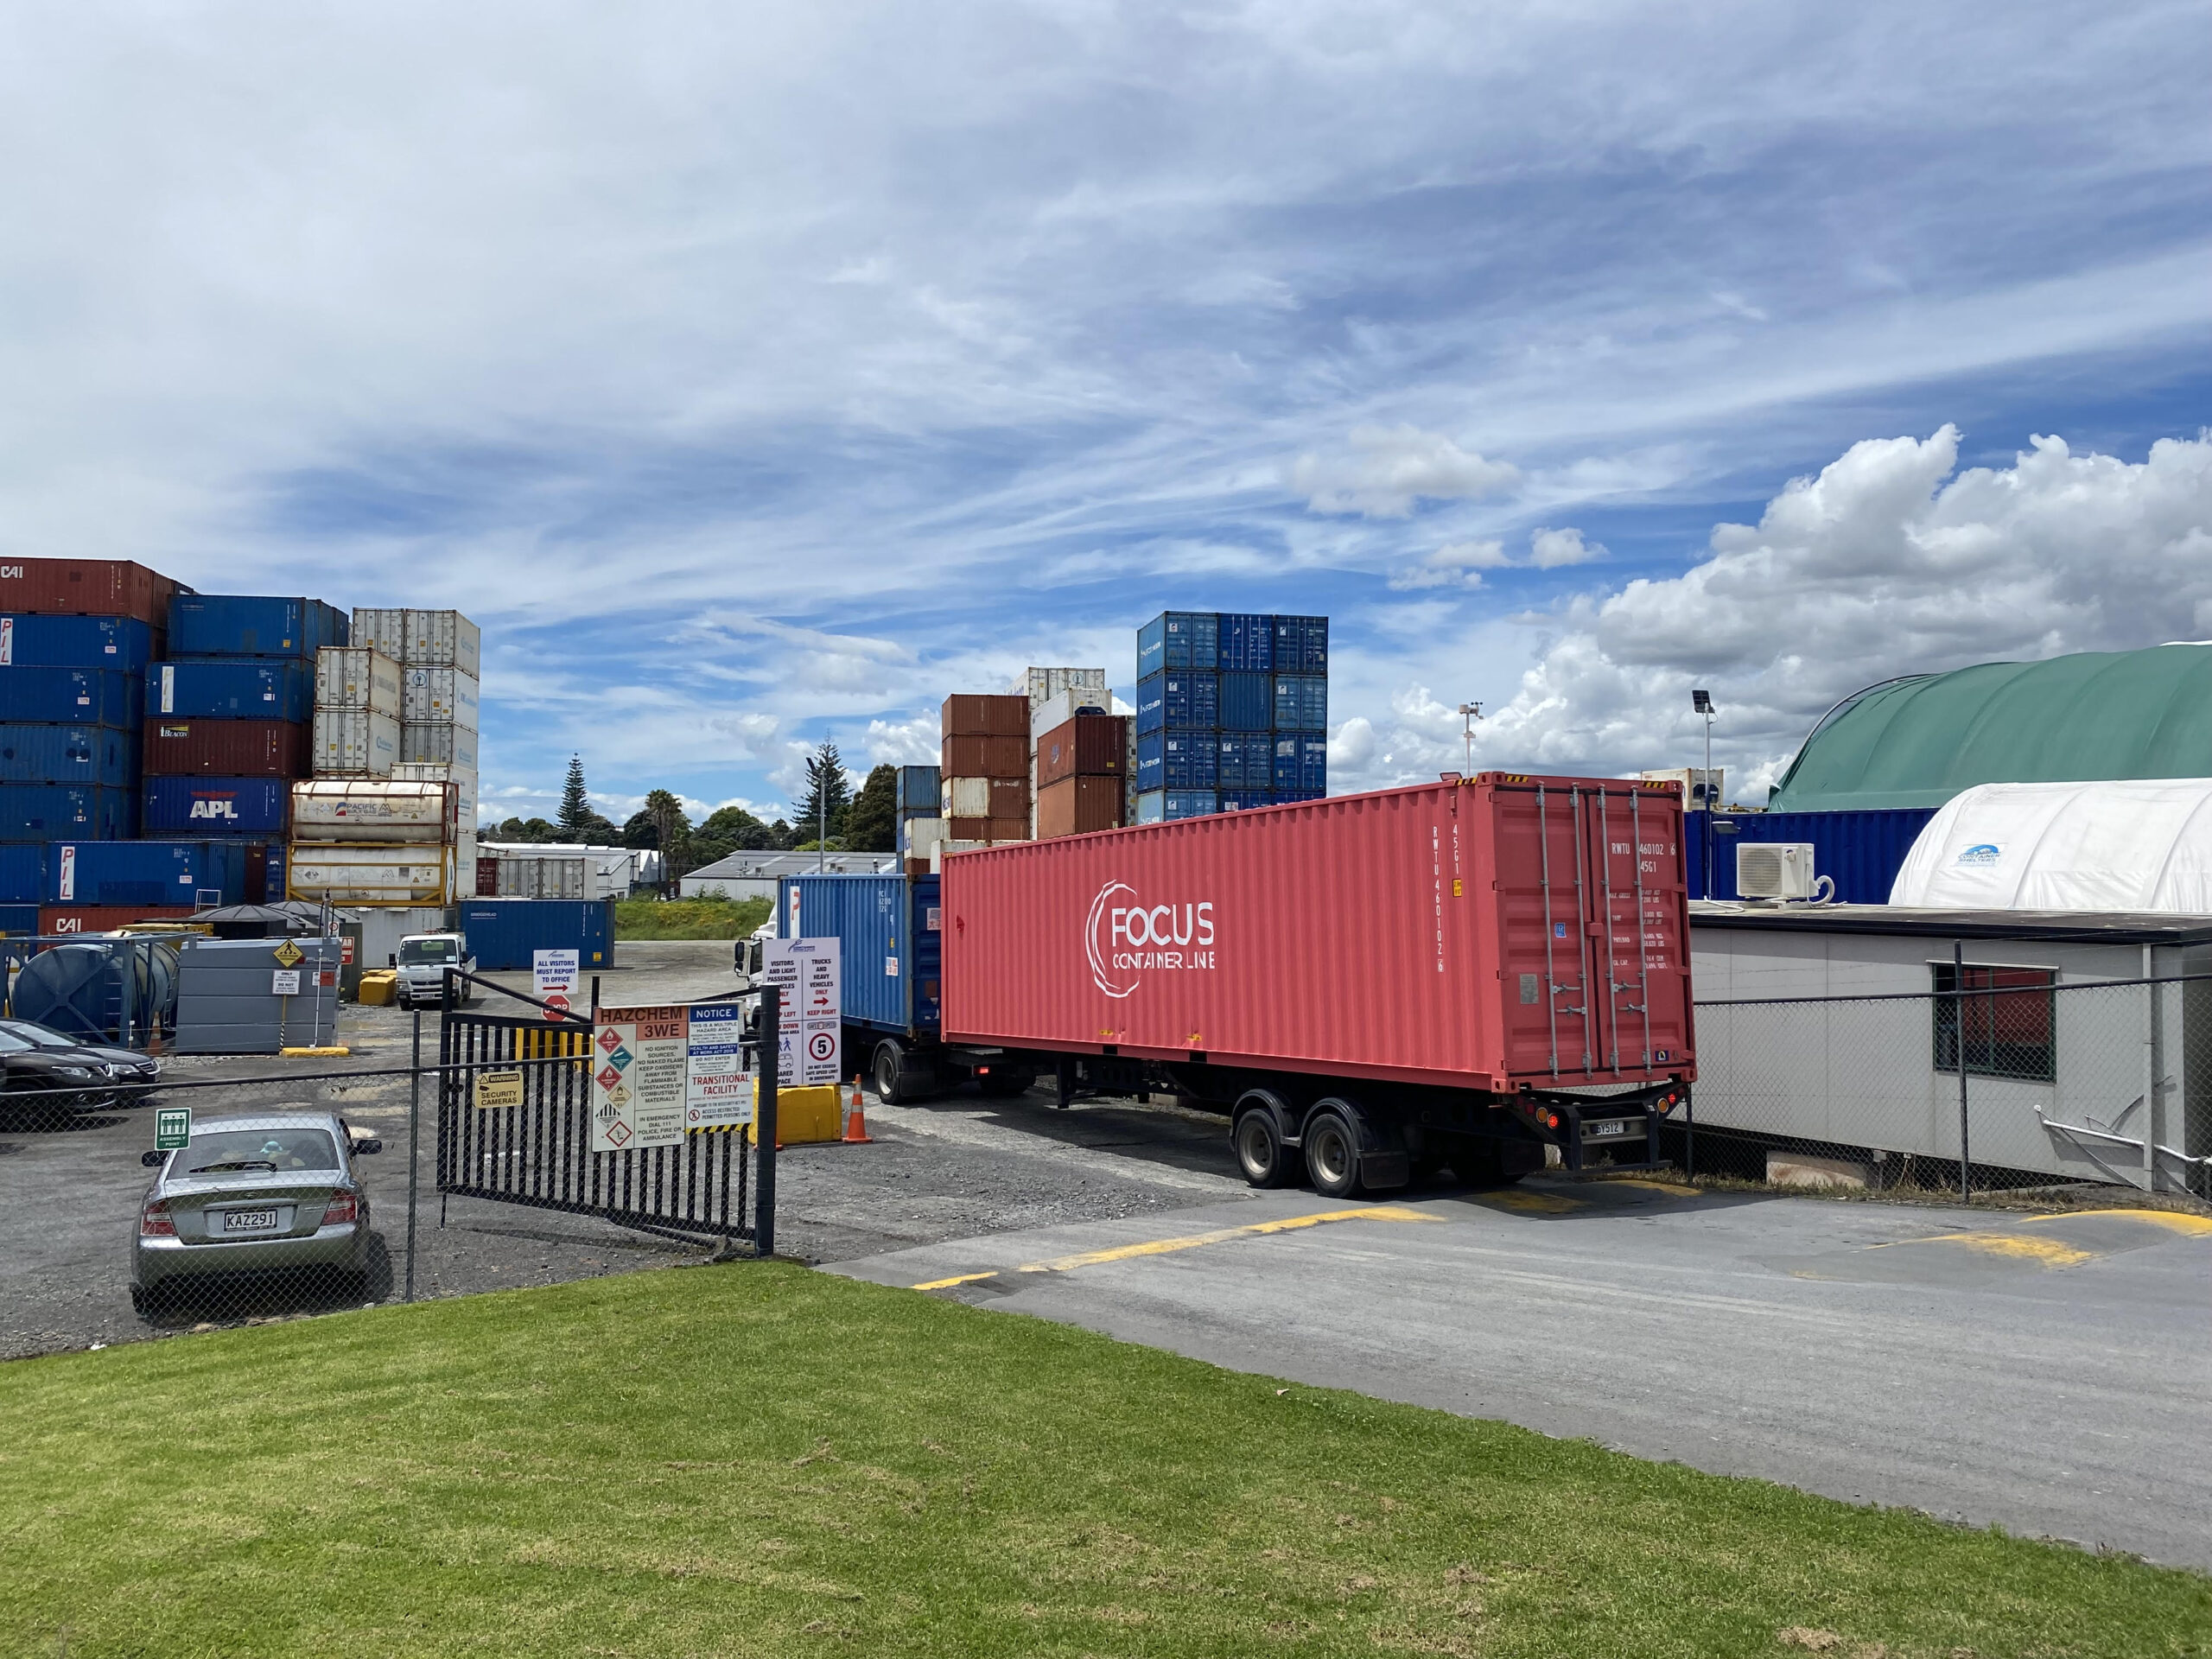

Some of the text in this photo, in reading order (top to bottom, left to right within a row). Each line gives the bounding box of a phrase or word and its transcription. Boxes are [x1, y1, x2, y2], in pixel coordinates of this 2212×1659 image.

[1, 566, 23, 578] CAI
[1, 620, 11, 663] PIL
[190, 801, 238, 818] APL
[1611, 842, 1630, 855] RWTU
[1639, 842, 1664, 855] 460102
[61, 849, 73, 897] PIL
[1640, 861, 1656, 873] 45G1
[56, 918, 81, 932] CAI
[1111, 901, 1215, 947] FOCUS
[1113, 951, 1215, 969] CONTAINER LINE
[601, 1007, 682, 1022] HAZCHEM
[696, 1008, 732, 1018] NOTICE
[645, 1023, 679, 1038] 3WE
[817, 1039, 827, 1054] 5
[692, 1074, 750, 1085] TRANSITIONAL
[703, 1084, 738, 1095] FACILITY
[226, 1213, 273, 1227] KAZ291
